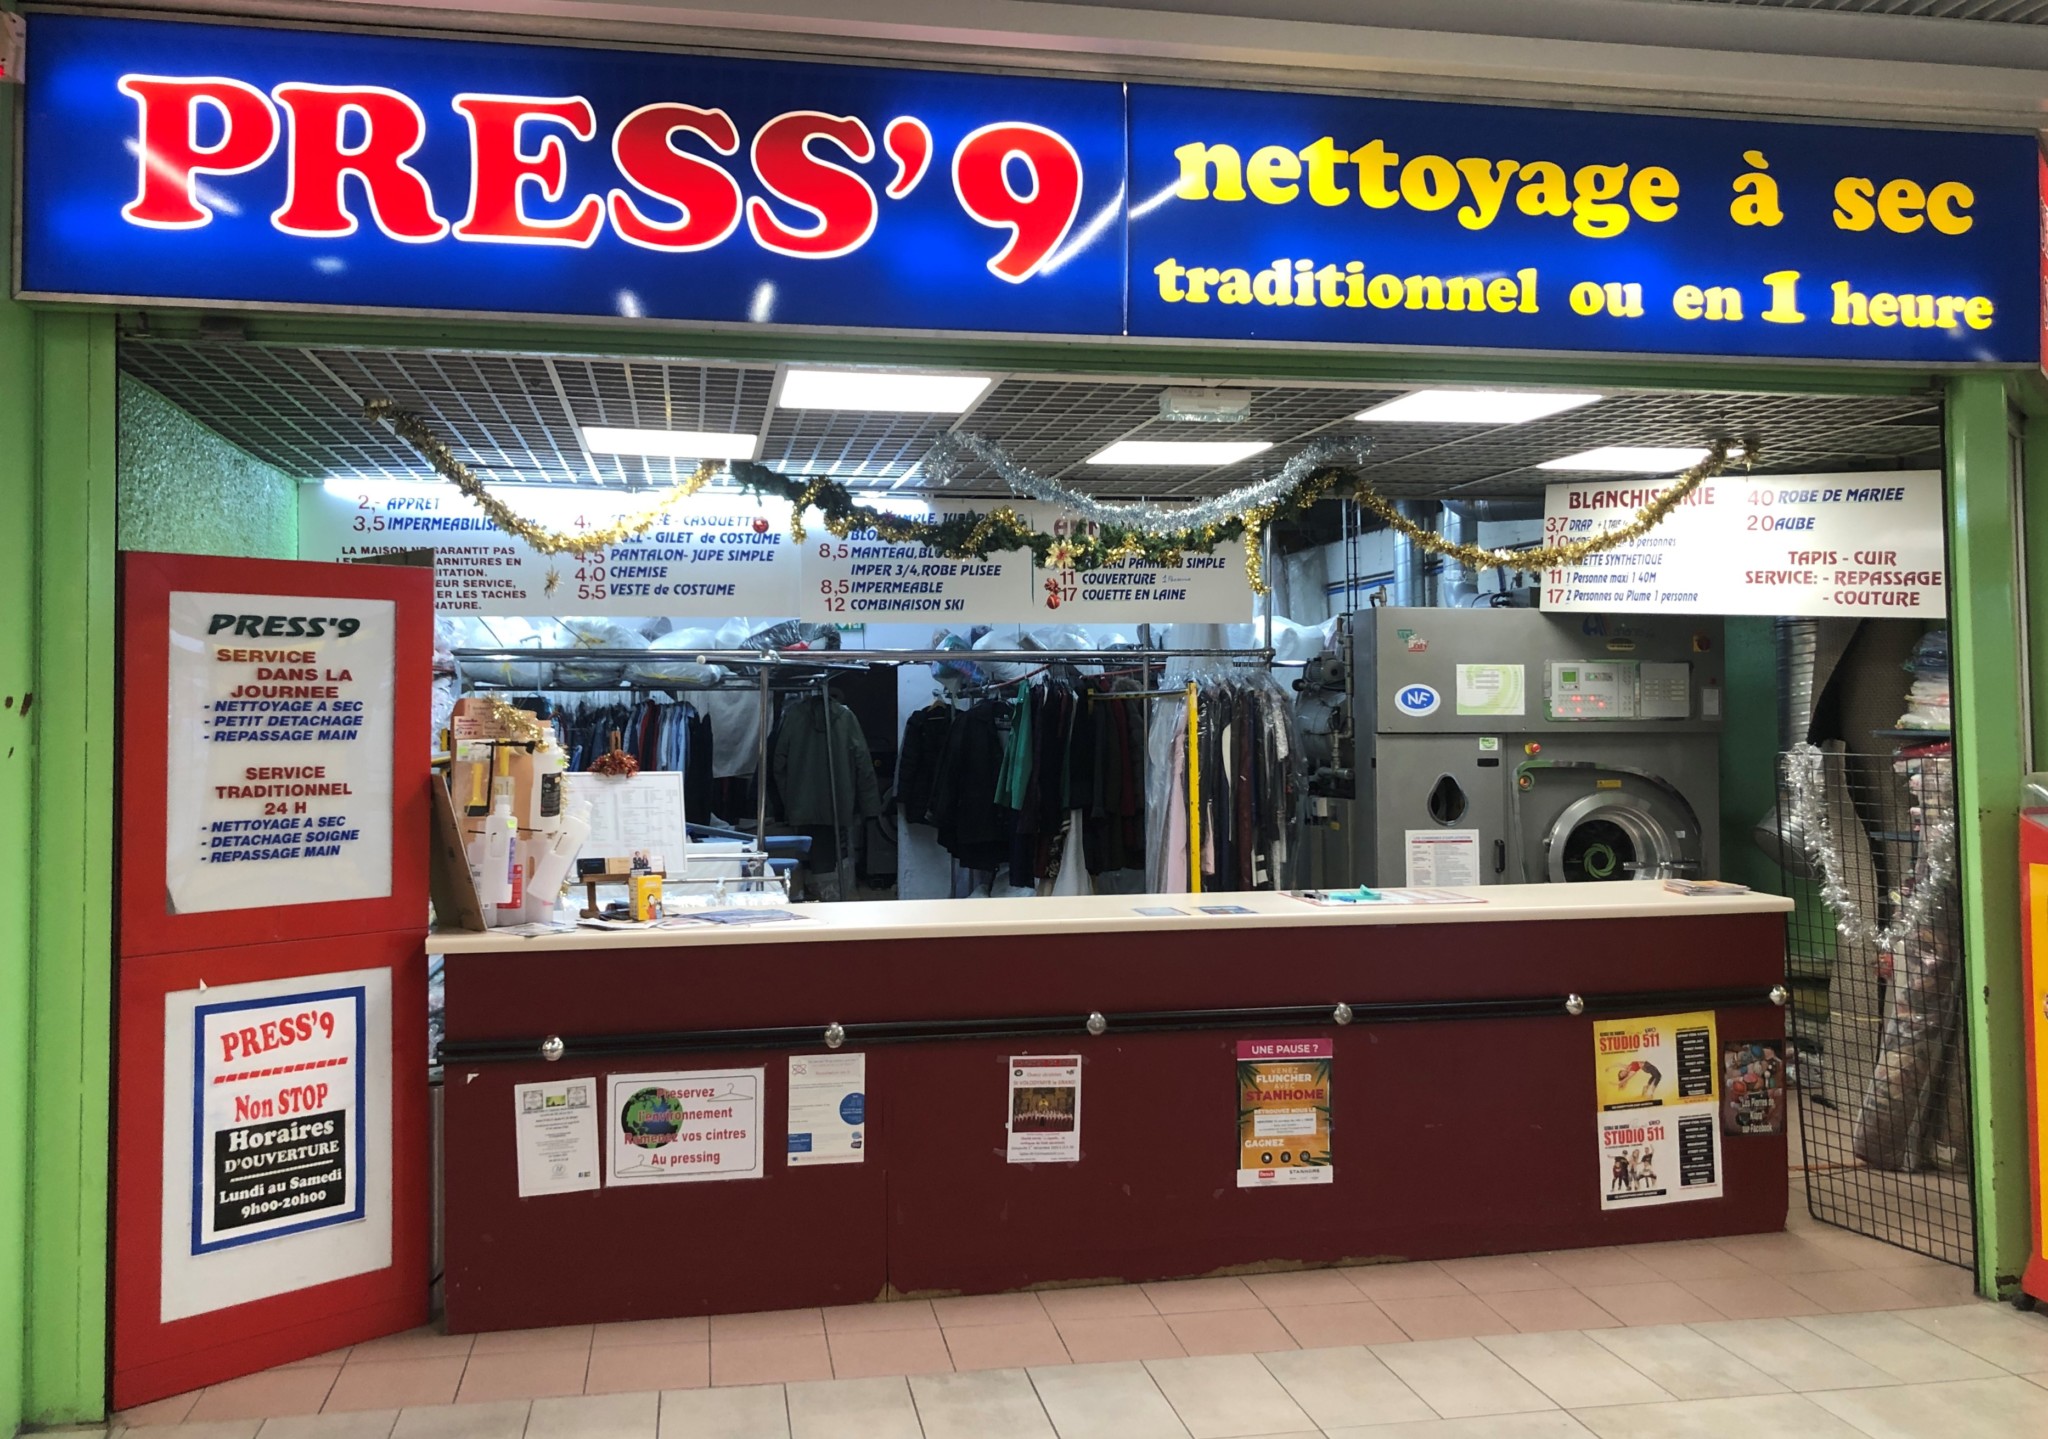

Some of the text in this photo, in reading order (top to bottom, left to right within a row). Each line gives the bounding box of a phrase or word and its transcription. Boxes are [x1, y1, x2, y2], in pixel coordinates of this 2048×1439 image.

[118, 72, 1085, 285] PRESS'9
[1173, 135, 1975, 239] nettoyage à sec
[1153, 257, 1994, 331] traditionnel ou en 1 heure
[386, 497, 440, 511] APPRET
[1568, 487, 1715, 510] BLANCHISRIE
[1747, 487, 1905, 506] 40 ROBE DE MARIEE
[352, 515, 385, 534] 3,5
[683, 515, 757, 527] CASQUETT
[1545, 516, 1569, 535] 3,7
[1569, 519, 1593, 531] DRAP
[1746, 515, 1816, 532] 20 AUBE
[655, 532, 693, 544] GILET
[700, 532, 716, 544] de
[719, 532, 781, 544] COSTUME
[1636, 538, 1677, 549] personnes
[341, 546, 357, 555] LA
[361, 546, 406, 555] MAISON
[493, 546, 516, 555] PAS
[690, 549, 725, 563] JUPE
[727, 550, 775, 562] SIMPLE
[818, 543, 849, 561] 8,5
[436, 557, 522, 566] ARNITURES EN
[1185, 557, 1226, 569] SIMPLE
[1605, 554, 1663, 567] SYNTHETIQUE
[1788, 551, 1897, 567] TAPIS CUIR
[574, 566, 668, 583] 4,0 CHEMISE
[850, 564, 892, 577] IMPER
[960, 564, 1002, 577] PLISEE
[1059, 571, 1157, 586] 11 COUVERTURE
[1548, 570, 1562, 584] 11
[1572, 571, 1607, 584] Personne
[1609, 572, 1629, 584] maxi
[463, 579, 516, 589] SERVICE,
[1834, 571, 1943, 587] REPASSAGE
[456, 590, 478, 599] LES
[482, 590, 527, 599] TACHES
[577, 584, 736, 600] 5,5 VESTE de COSTUME
[820, 579, 944, 597] 8,5 IMPERMEABLE
[1060, 587, 1187, 602] 17 COUETTE EN LAINE
[1547, 588, 1565, 604] 17
[1573, 589, 1612, 602] Personnes
[1614, 592, 1624, 602] ou
[1626, 589, 1652, 602] Plume
[1660, 591, 1699, 604] personne
[824, 597, 965, 612] 12 COMBINAISON SKI
[1833, 591, 1920, 607] COUTURE
[207, 613, 361, 639] PRESS'9
[216, 648, 317, 664] SERVICE
[257, 667, 353, 682] DANS LA
[230, 684, 339, 699] JOURNEE
[214, 700, 364, 712] NETTOYAGE A SEC
[214, 715, 364, 727] PETIT DETACHAGE
[214, 729, 358, 742] REPASSAGE MAIN
[245, 766, 326, 781] SERVICE
[215, 783, 353, 799] TRADITIONNEL
[264, 801, 307, 816] 24 H
[211, 816, 346, 833] NETTOYAGE A SEC
[210, 829, 360, 848] DETACHAGE SOIGNE
[210, 845, 341, 863] REPASSAGE MAIN
[220, 1010, 335, 1063] PRESS'9
[1600, 1032, 1660, 1052] STUDIO 511
[1251, 1045, 1274, 1055] UNE
[1276, 1044, 1311, 1055] PAUSE
[1256, 1073, 1312, 1084] FLUNCHER
[656, 1087, 715, 1099] Preservez
[1246, 1088, 1324, 1102] STANHOME
[234, 1083, 329, 1122] Non STOP
[638, 1106, 733, 1122] l'environnement
[228, 1119, 334, 1152] Horaires
[682, 1132, 702, 1142] vos
[705, 1128, 747, 1140] cintres
[1604, 1128, 1645, 1146] STUDIO
[1647, 1126, 1665, 1141] 511
[1244, 1139, 1285, 1148] GAGNEZ
[224, 1139, 340, 1173] D'OUVERTURE
[651, 1151, 721, 1167] Au pressing
[219, 1168, 343, 1204] Lundi au Samedi
[241, 1190, 327, 1219] 9h00-20h00
